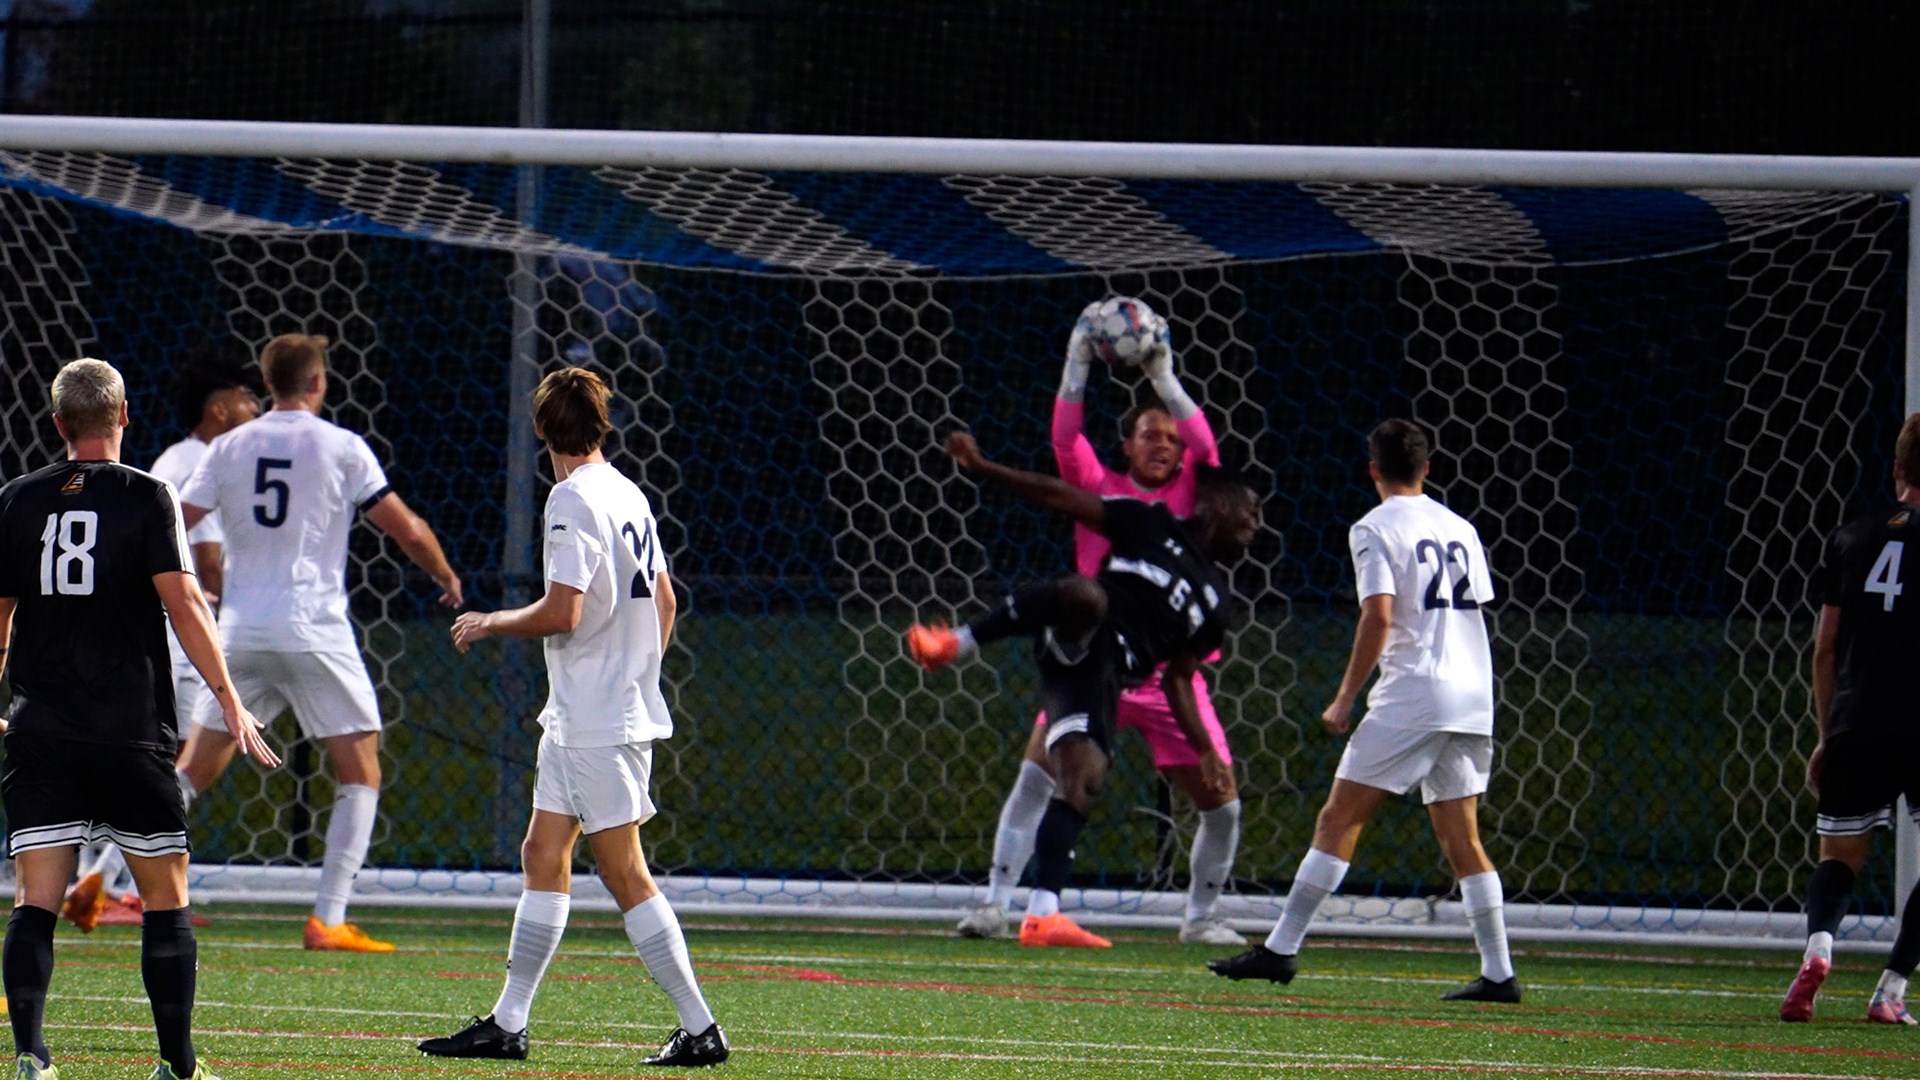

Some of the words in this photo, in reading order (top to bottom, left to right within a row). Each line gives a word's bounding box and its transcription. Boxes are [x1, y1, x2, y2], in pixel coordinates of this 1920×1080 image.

[252, 457, 293, 528] 5
[40, 510, 98, 596] 18
[1416, 538, 1479, 610] 22
[1864, 540, 1905, 612] 4
